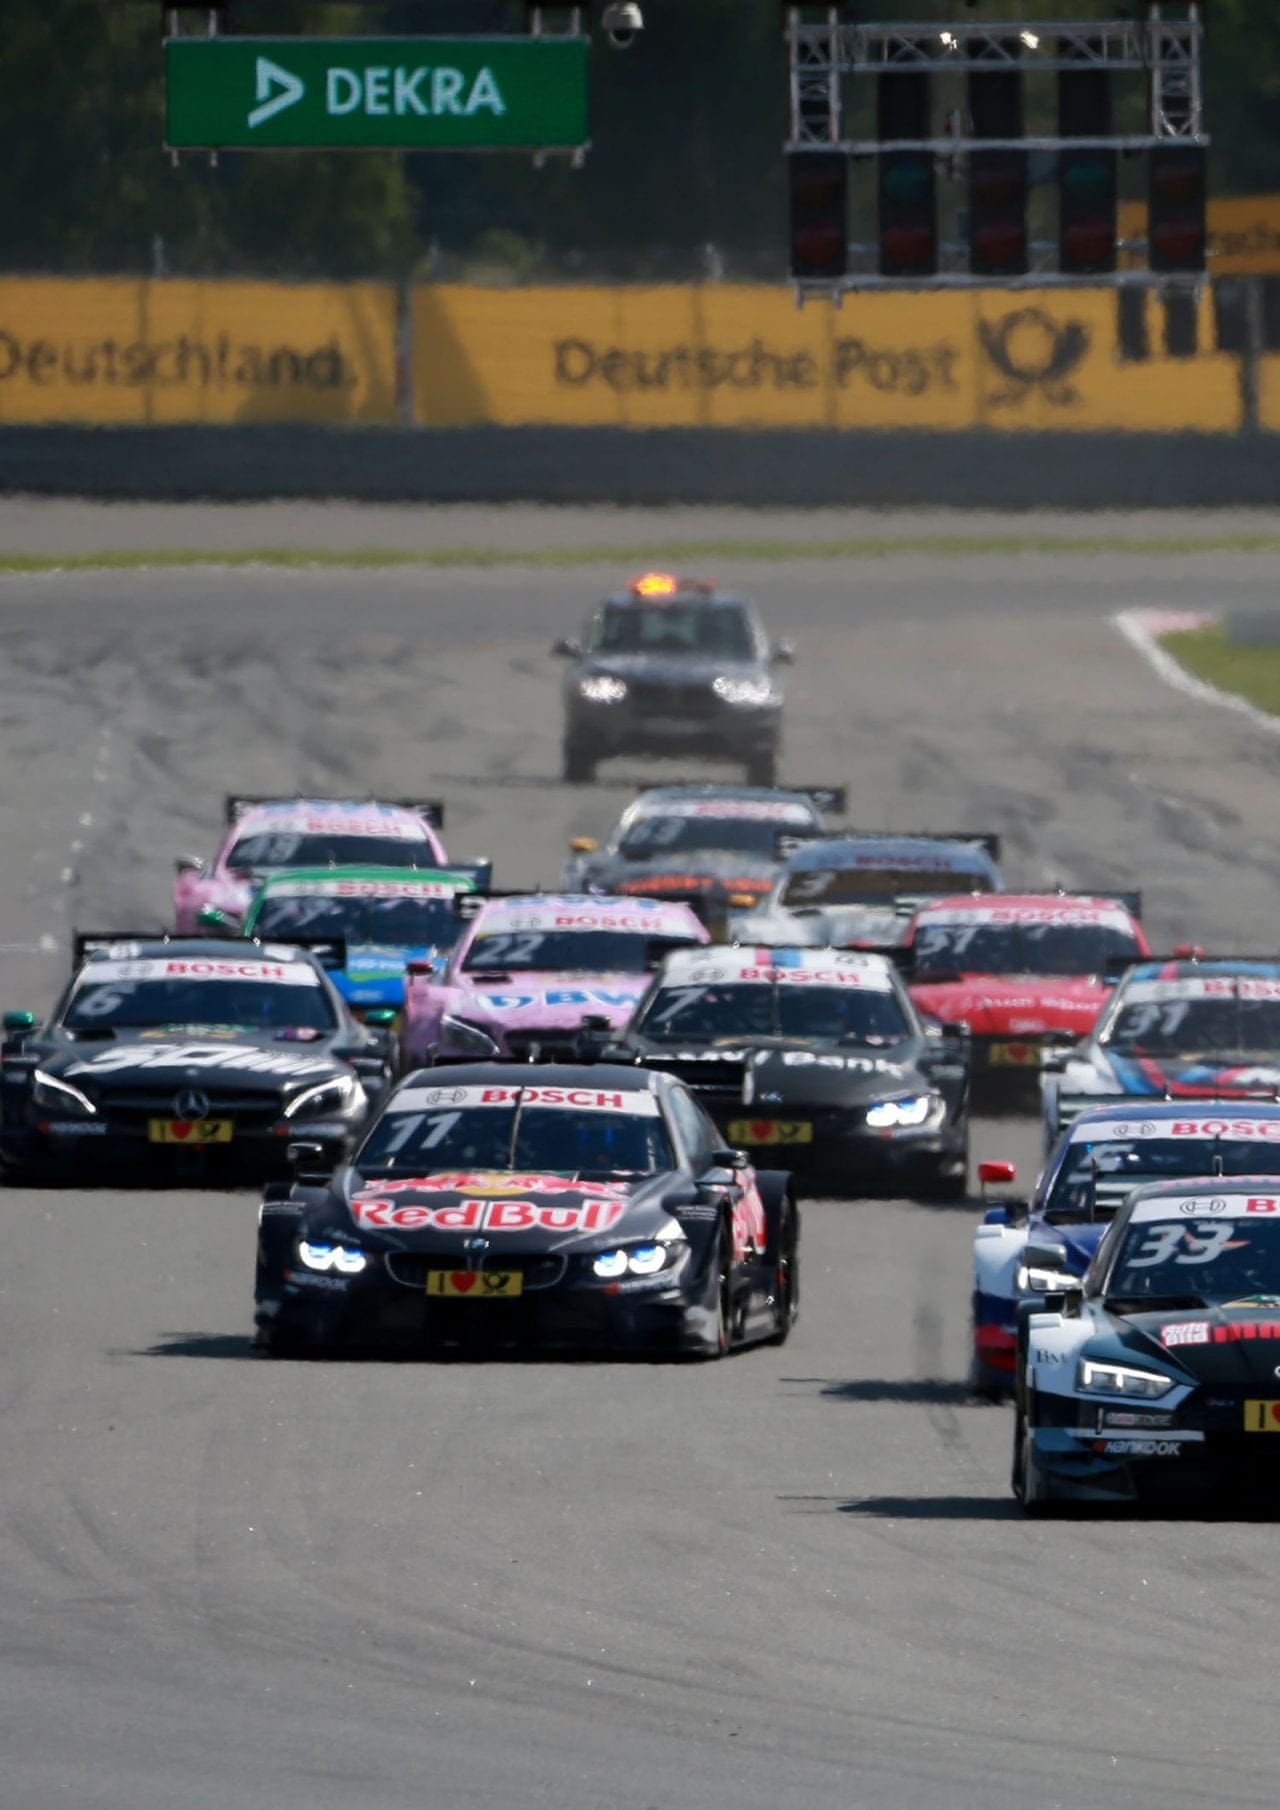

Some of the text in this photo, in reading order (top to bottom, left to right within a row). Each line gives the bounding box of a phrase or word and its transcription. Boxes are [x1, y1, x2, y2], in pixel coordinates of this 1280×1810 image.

[326, 66, 504, 117] DEKRA
[554, 336, 960, 396] Deutsche Post
[554, 914, 663, 931] BOSCH
[470, 934, 546, 965] 22
[165, 961, 285, 978] BOSCH
[738, 968, 861, 985] BOSCH
[76, 985, 126, 1016] 6
[481, 1089, 624, 1108] BOSCH
[386, 1112, 462, 1151] 11
[1127, 1222, 1236, 1268] 33
